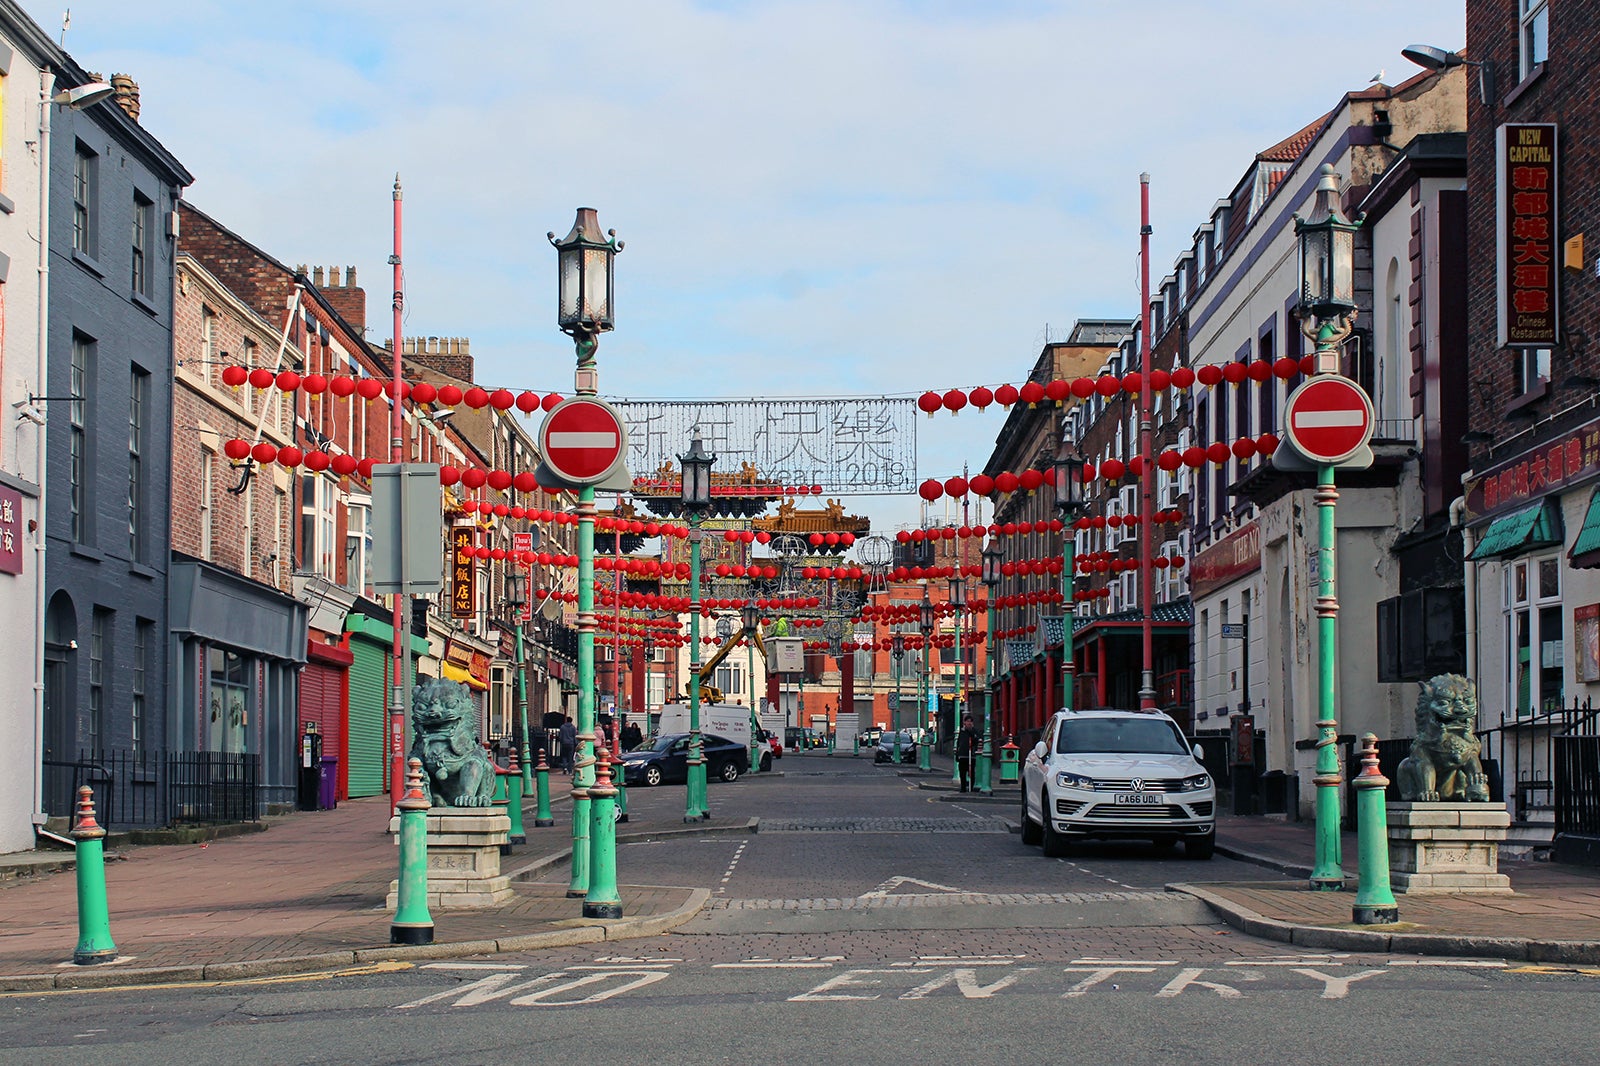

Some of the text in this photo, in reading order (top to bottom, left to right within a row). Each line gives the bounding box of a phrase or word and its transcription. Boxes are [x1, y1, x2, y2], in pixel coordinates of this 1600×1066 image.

[1519, 129, 1541, 144] NEW
[1509, 146, 1551, 162] CAPITAL
[1517, 315, 1547, 327] Chinese
[1511, 326, 1553, 339] Restaurant
[758, 466, 824, 486] Year
[846, 462, 904, 486] 2018
[1233, 534, 1249, 567] THE
[456, 601, 471, 610] NG
[1118, 795, 1159, 804] CA66 UDL
[393, 967, 1389, 1009] NO ENTRY
